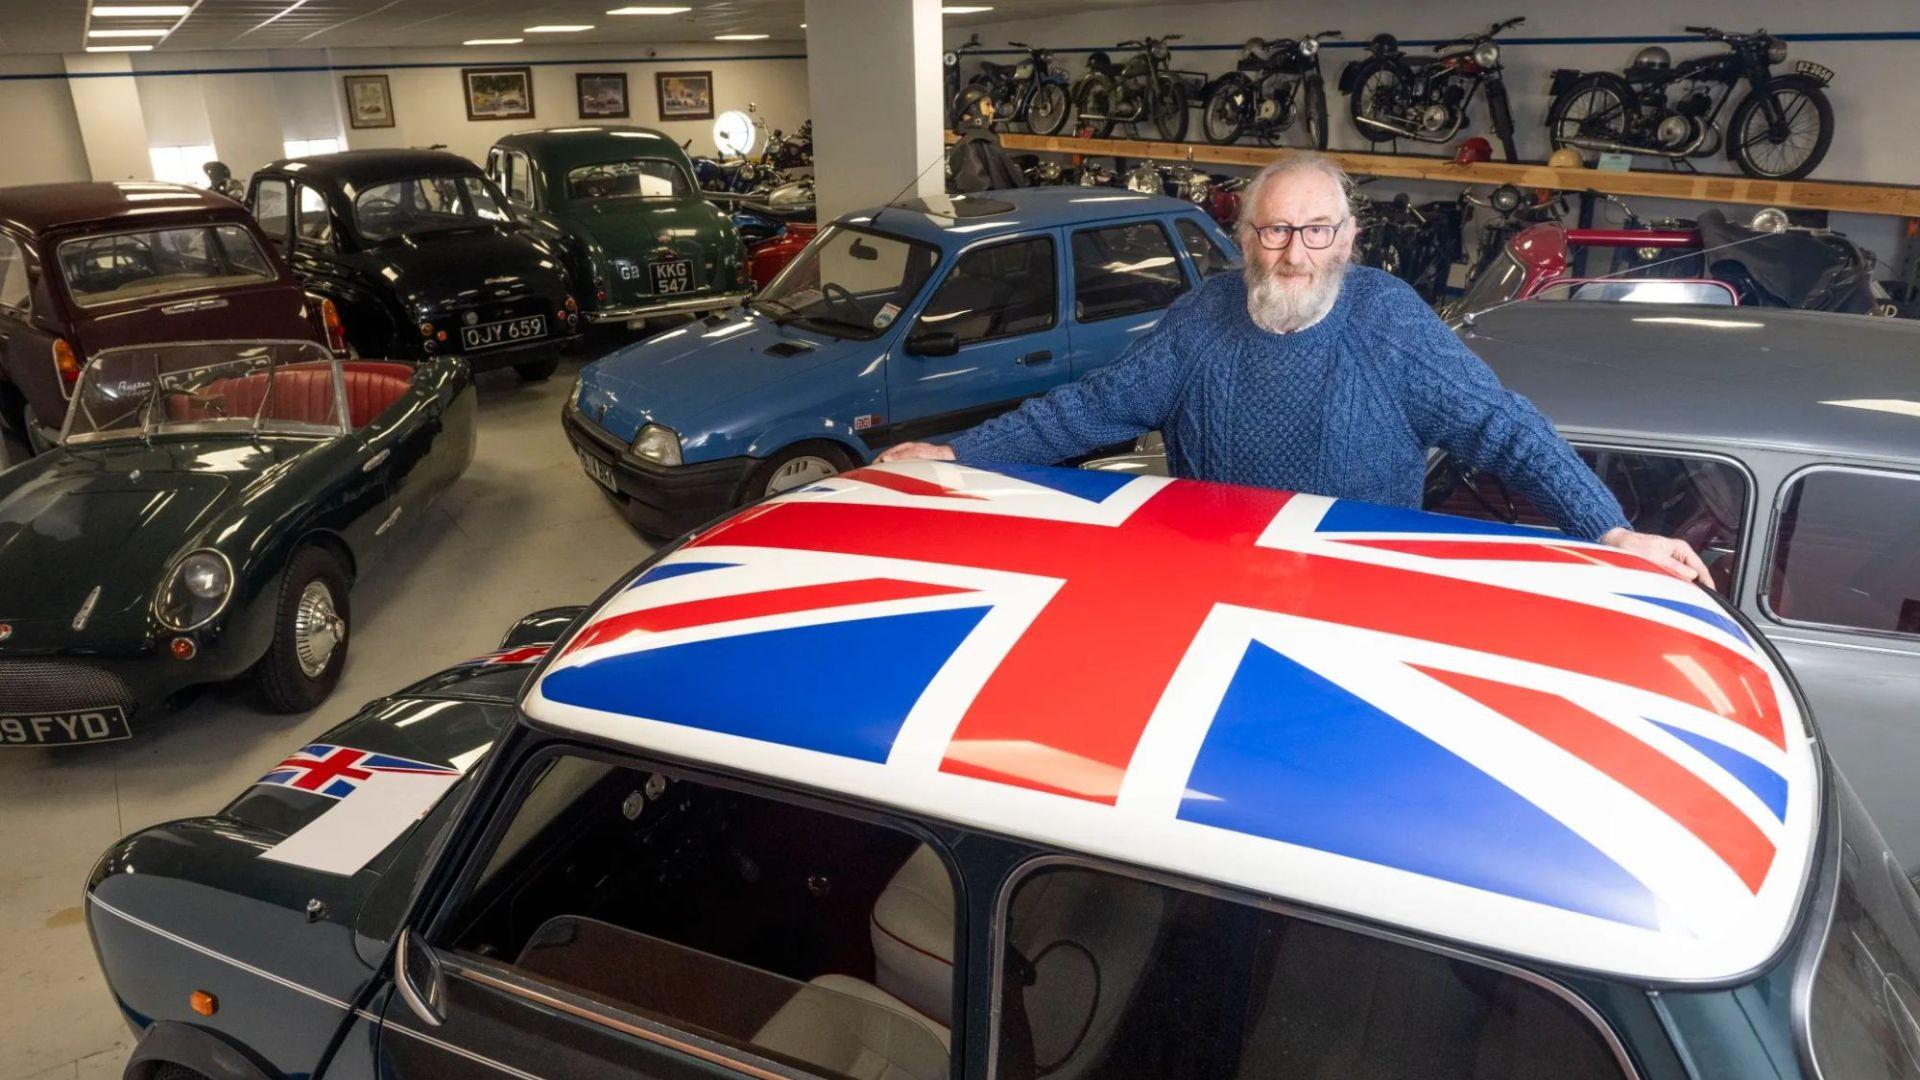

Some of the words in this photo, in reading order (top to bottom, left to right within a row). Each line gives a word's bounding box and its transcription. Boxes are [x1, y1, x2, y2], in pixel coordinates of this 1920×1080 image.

[621, 264, 640, 280] GB
[656, 263, 686, 278] KKG
[658, 278, 688, 293] 547
[467, 325, 502, 345] OJY
[509, 318, 541, 338] 659
[0, 718, 27, 743] 9
